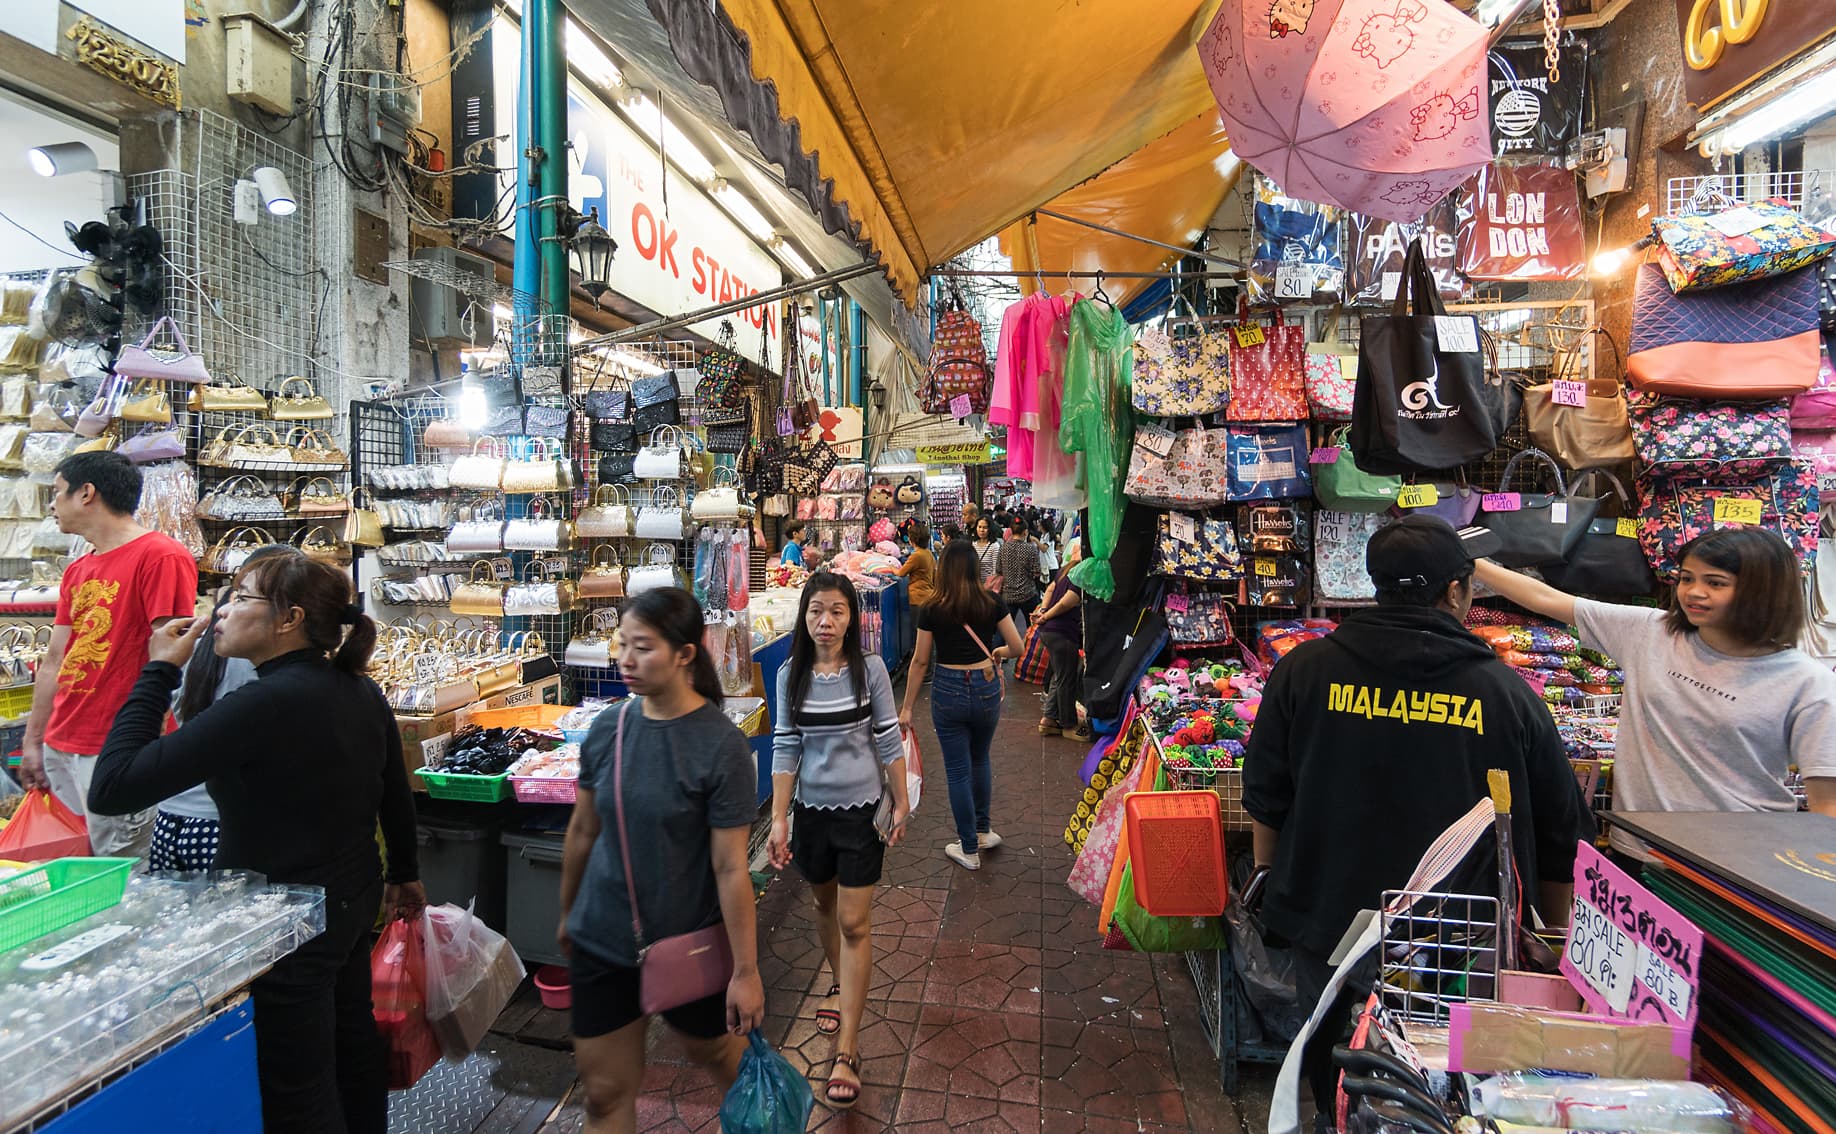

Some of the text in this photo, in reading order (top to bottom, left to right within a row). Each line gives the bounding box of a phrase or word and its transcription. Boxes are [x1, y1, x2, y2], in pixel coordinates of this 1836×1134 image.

[619, 159, 644, 192] THE
[1487, 192, 1546, 225] LON
[1488, 226, 1550, 258] DON
[631, 202, 776, 340] OK STATION
[1440, 319, 1471, 335] SALE
[1253, 513, 1294, 529] Harrods
[1320, 510, 1346, 525] SALE
[1260, 574, 1296, 587] Harrods
[504, 686, 534, 706] NESCAFÉ
[1328, 683, 1484, 735] MALAYSIA
[1593, 914, 1626, 957] SALE
[1644, 968, 1664, 995] 80
[1648, 952, 1676, 984] SALE
